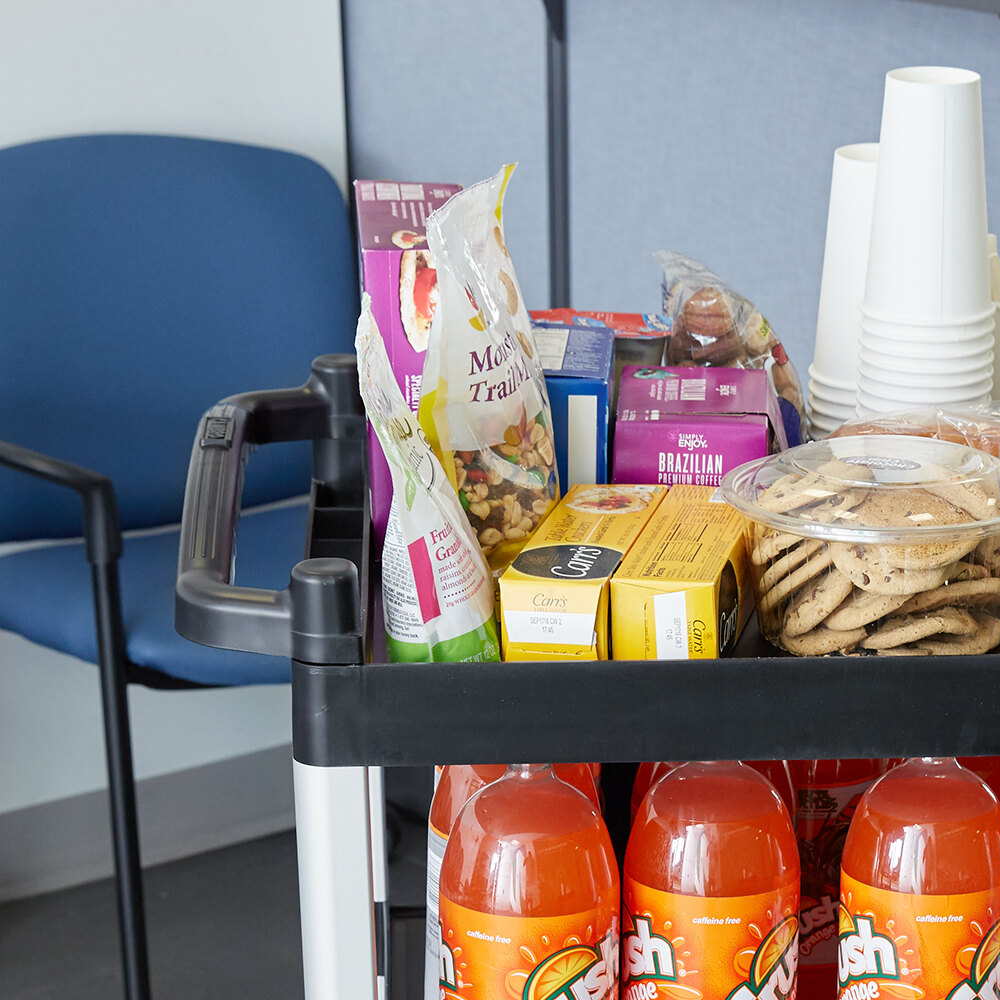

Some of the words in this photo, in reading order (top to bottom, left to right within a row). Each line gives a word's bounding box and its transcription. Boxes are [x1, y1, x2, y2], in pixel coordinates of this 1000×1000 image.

[678, 439, 706, 451] ENJOY
[658, 452, 723, 475] BRAZILIAN
[658, 473, 693, 485] PREMIUM
[695, 474, 722, 486] COFFEE
[551, 546, 602, 578] Carr's
[532, 593, 568, 608] Carr's
[693, 619, 707, 654] Carr's
[692, 916, 724, 925] caffeine
[725, 917, 741, 925] free
[799, 895, 840, 934] ush
[916, 915, 947, 923] caffeine
[948, 915, 963, 923] free
[466, 929, 494, 943] caffeine
[495, 935, 511, 944] free
[838, 918, 897, 983] ush
